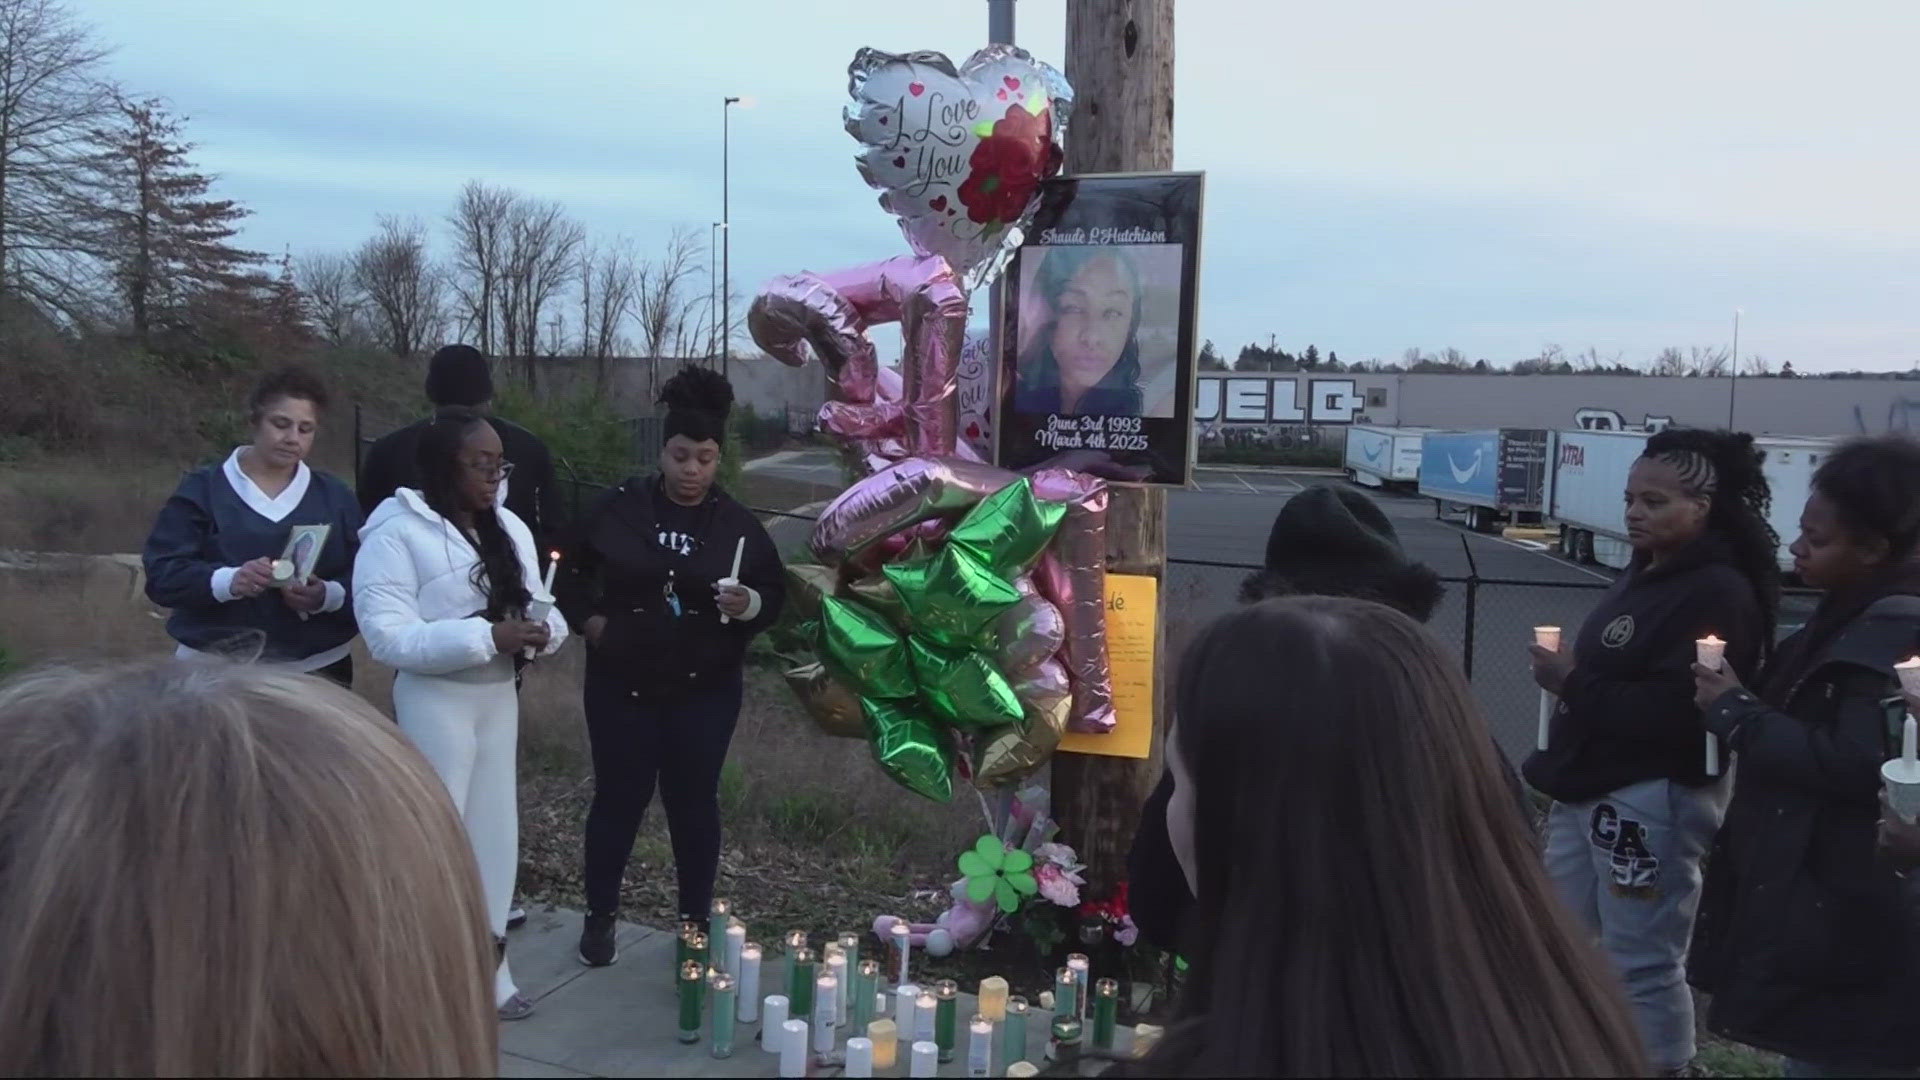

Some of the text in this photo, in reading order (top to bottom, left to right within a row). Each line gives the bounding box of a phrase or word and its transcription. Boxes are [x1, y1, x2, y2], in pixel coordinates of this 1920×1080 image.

[885, 92, 981, 150] I Love
[905, 145, 966, 198] You
[1100, 225, 1166, 244] Hutchison
[1047, 413, 1142, 433] June 3rd 1993
[1035, 429, 1149, 451] March 4th 2025
[1558, 443, 1584, 468] XTRA
